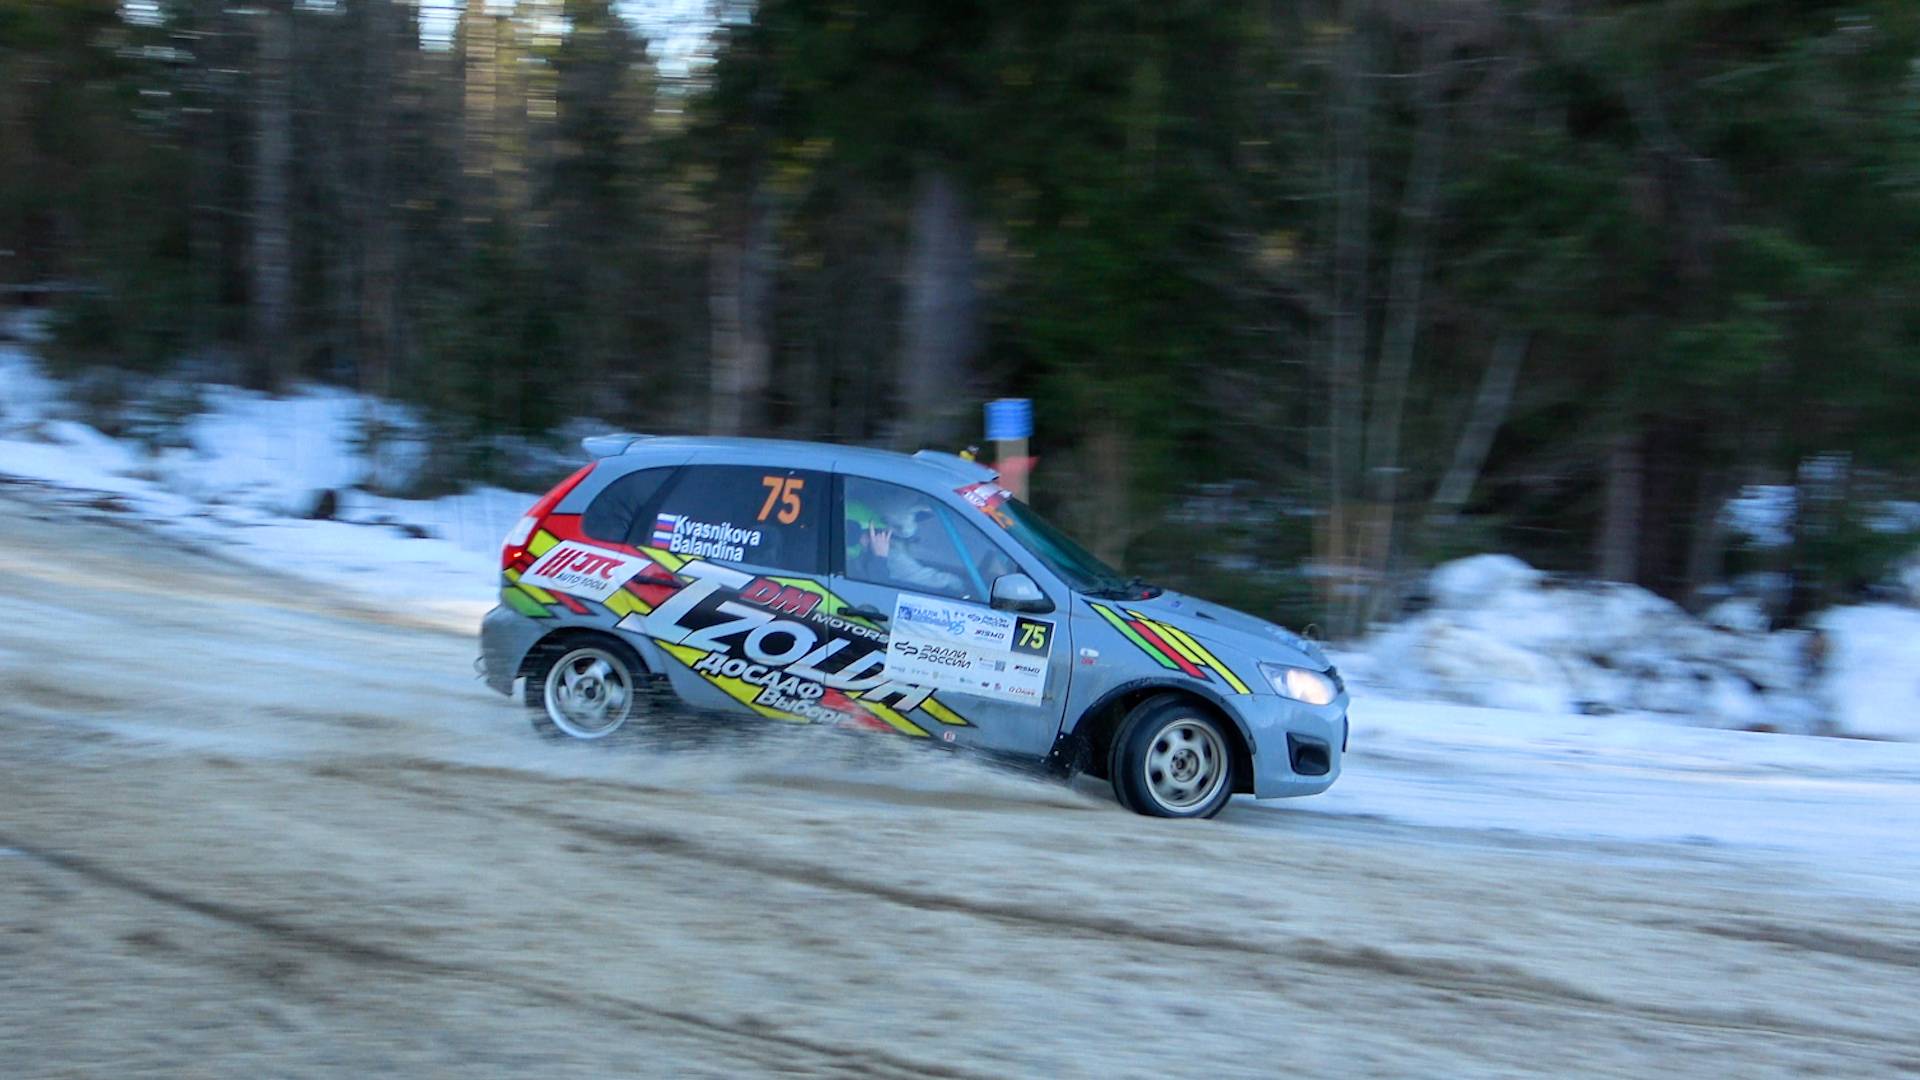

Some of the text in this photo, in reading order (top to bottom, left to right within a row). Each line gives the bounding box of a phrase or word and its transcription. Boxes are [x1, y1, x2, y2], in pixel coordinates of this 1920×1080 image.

[757, 476, 804, 525] 75
[673, 514, 762, 546] Kvasnikova
[669, 534, 745, 562] Balandina
[570, 552, 627, 580] JTC
[740, 577, 822, 617] DM
[812, 612, 888, 645] MOTORS
[1018, 623, 1047, 650] 75
[917, 652, 971, 670] РОССИИ
[921, 644, 968, 660] РАЛЛИ
[693, 653, 824, 699] ДОСААФ
